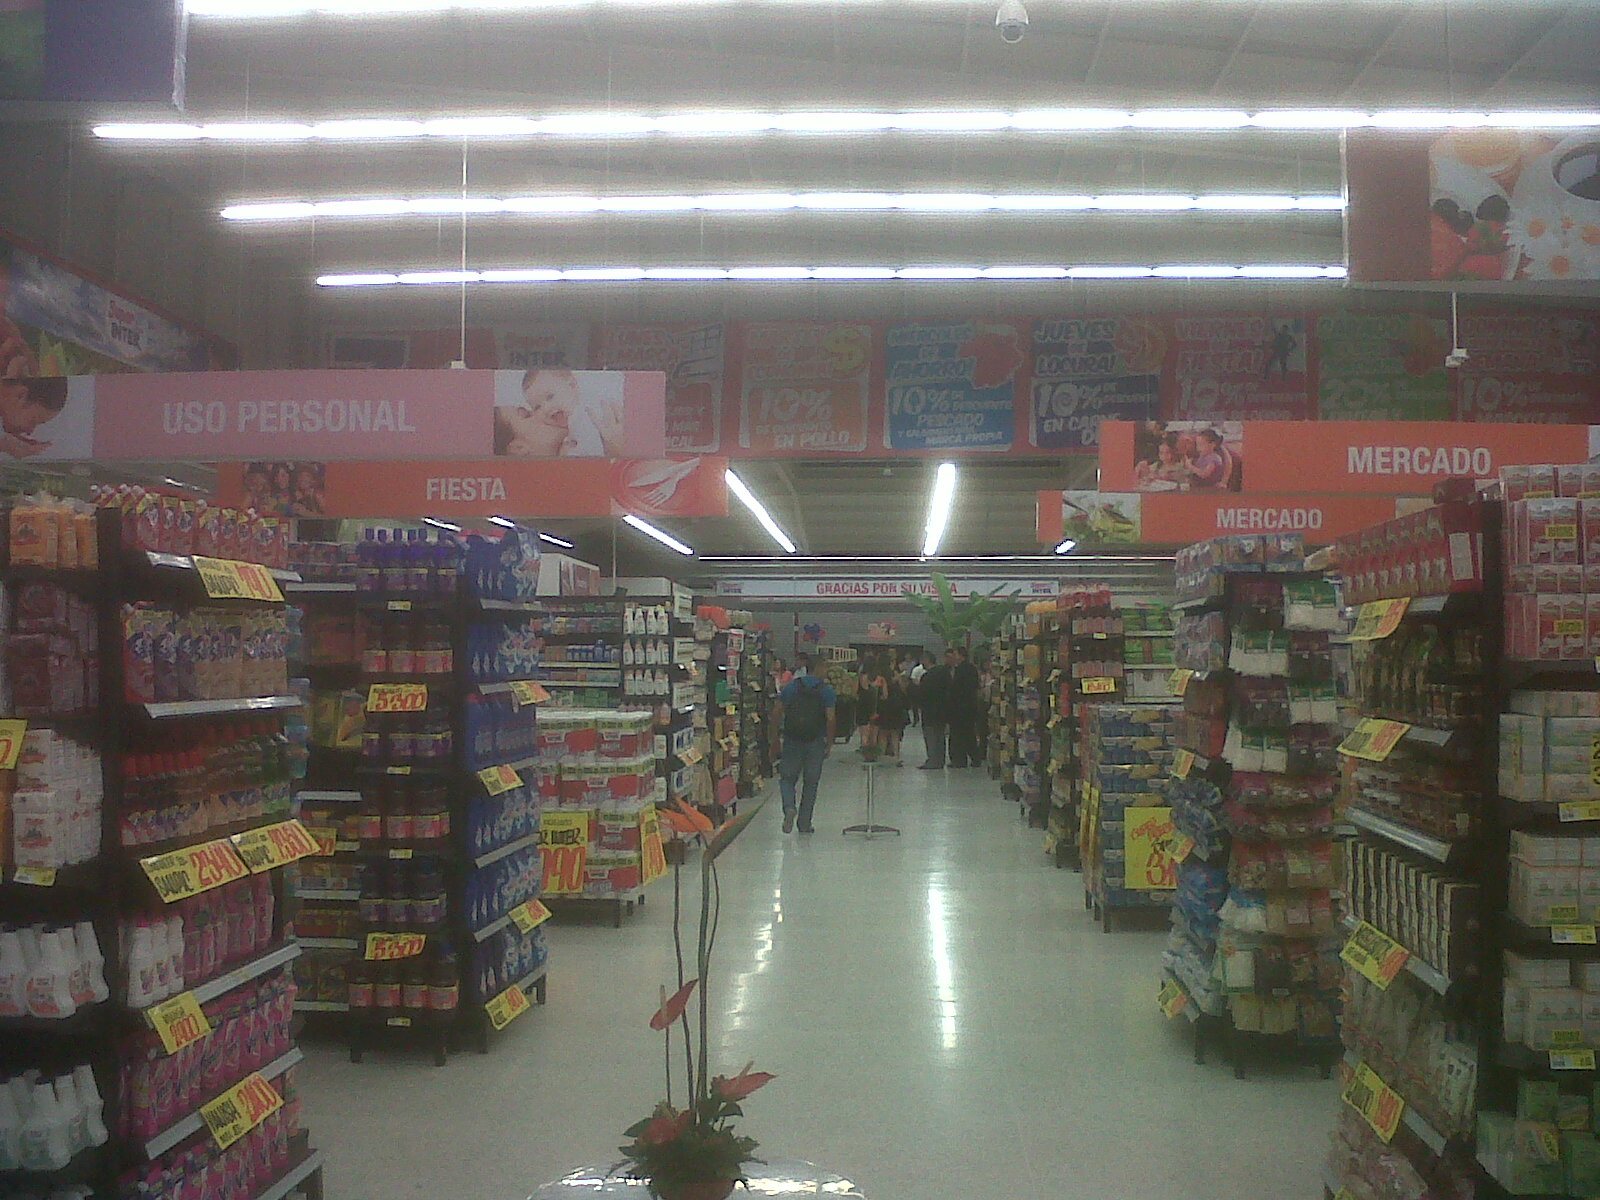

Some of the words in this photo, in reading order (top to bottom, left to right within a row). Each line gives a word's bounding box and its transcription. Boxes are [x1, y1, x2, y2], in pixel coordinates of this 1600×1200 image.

[759, 388, 832, 421] 10%
[892, 387, 950, 414] 10%
[1039, 382, 1102, 417] 10%
[163, 401, 226, 434] USO
[238, 398, 417, 434] PERSONAL
[917, 413, 984, 427] PESCADO
[1347, 447, 1492, 475] MERCADO
[426, 477, 506, 501] FIESTA
[1216, 508, 1323, 529] MERCADO
[816, 582, 869, 595] GRACIAS
[872, 582, 897, 594] POR
